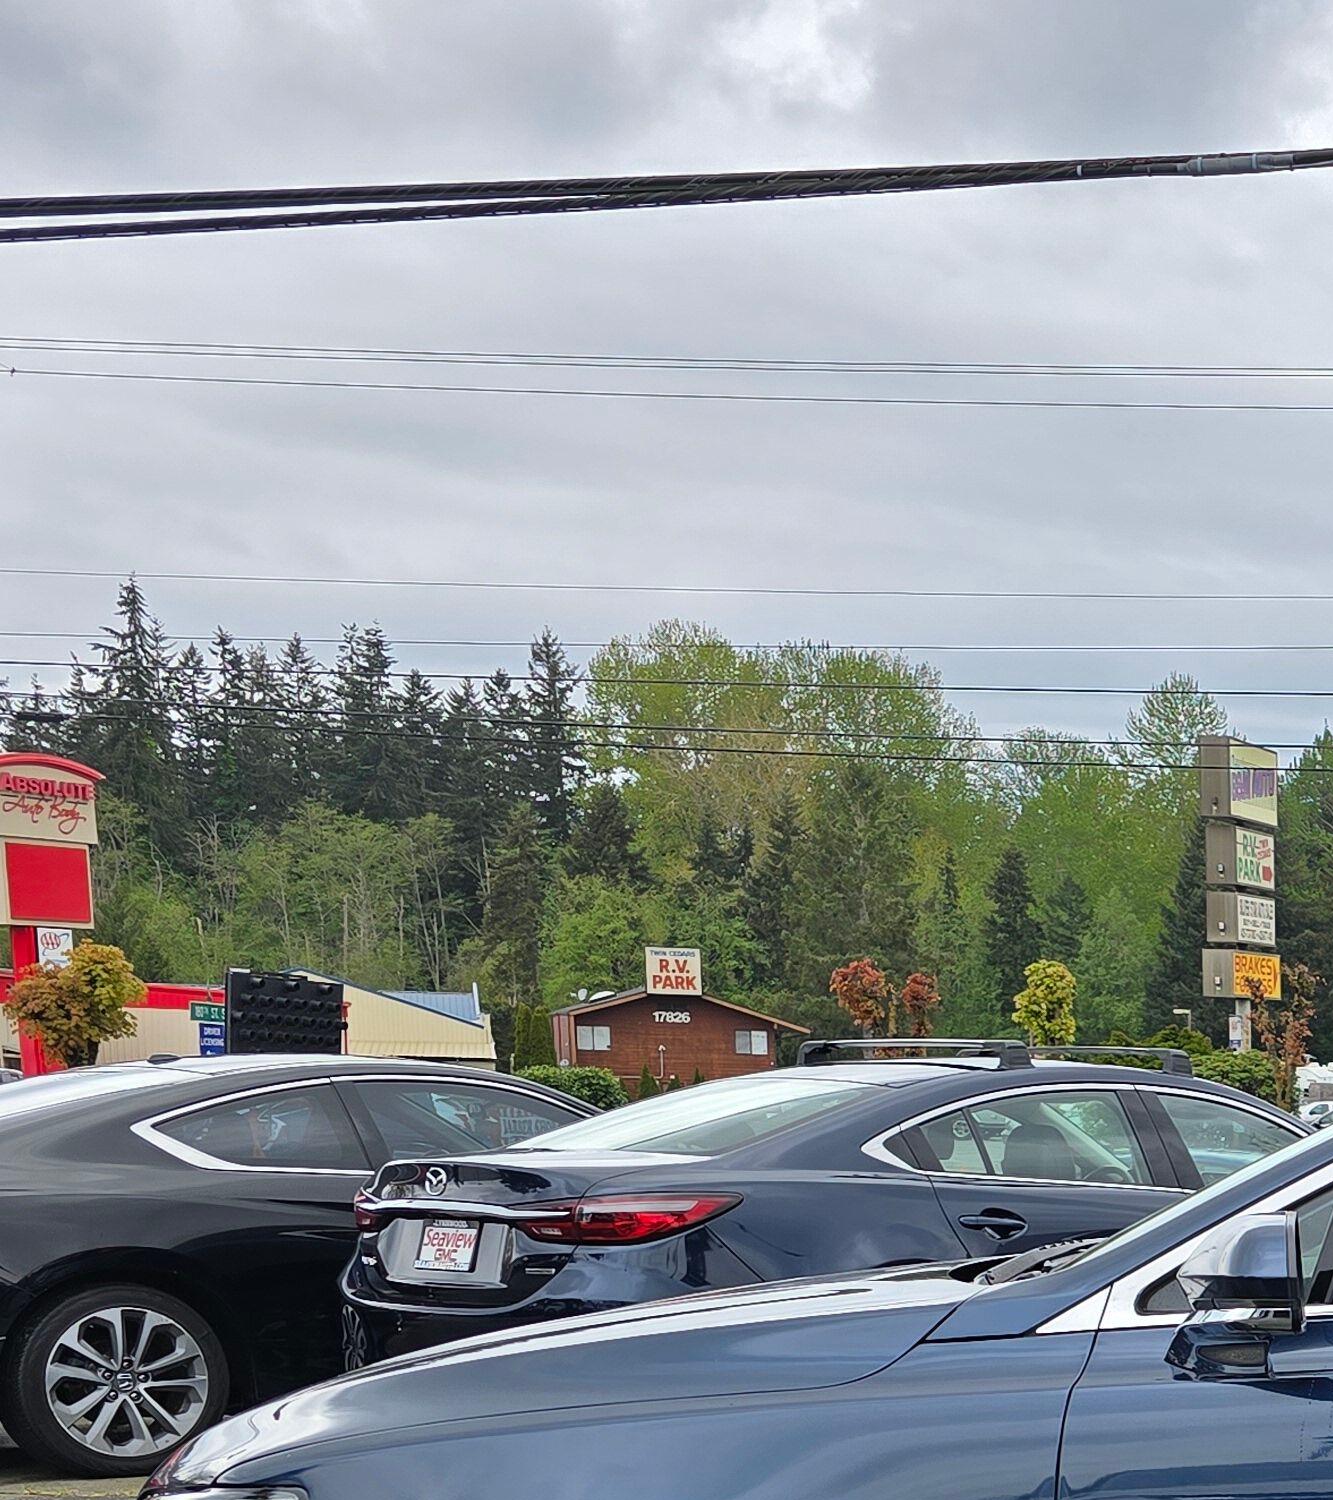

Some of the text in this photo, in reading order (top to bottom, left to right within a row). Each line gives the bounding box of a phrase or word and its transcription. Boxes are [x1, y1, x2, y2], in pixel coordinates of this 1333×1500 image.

[0, 772, 96, 800] ABSOLUTE
[1239, 857, 1261, 883] PARK
[650, 949, 696, 958] TWIN CEDARS
[659, 959, 690, 974] R.V.
[1235, 955, 1273, 976] BRAKES
[652, 975, 697, 990] PARK
[652, 1010, 691, 1023] 17826
[423, 1228, 477, 1248] Seaview
[434, 1248, 458, 1261] GMC
